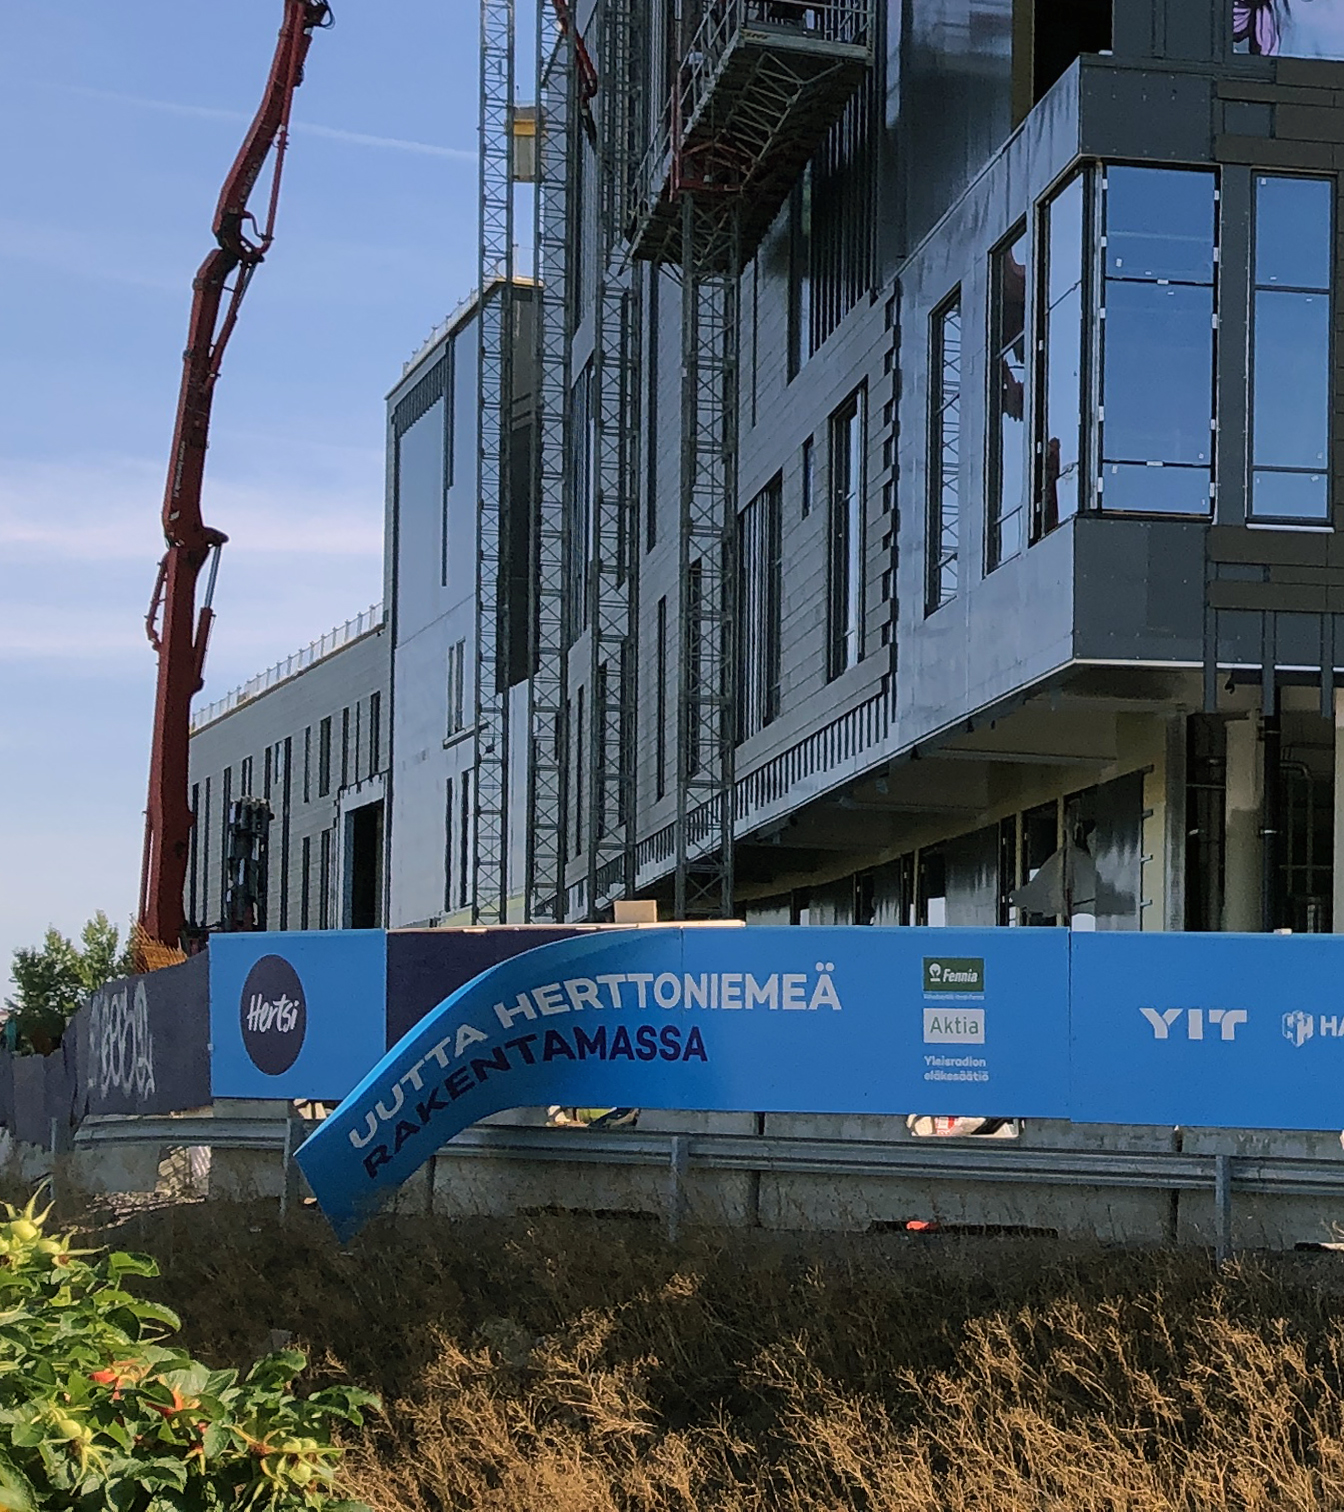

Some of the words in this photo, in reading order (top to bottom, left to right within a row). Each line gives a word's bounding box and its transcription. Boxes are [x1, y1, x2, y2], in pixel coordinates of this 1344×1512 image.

[943, 969, 978, 982] Fennia
[247, 992, 300, 1031] Hertsi
[930, 1017, 979, 1034] Aktia
[1139, 1008, 1248, 1040] YIT
[349, 1023, 488, 1148] UUTTA
[493, 962, 841, 1028] HERTTONIEMEÄ
[924, 1055, 987, 1067] Yleisradion
[362, 1025, 708, 1178] RAKENTAMASSA
